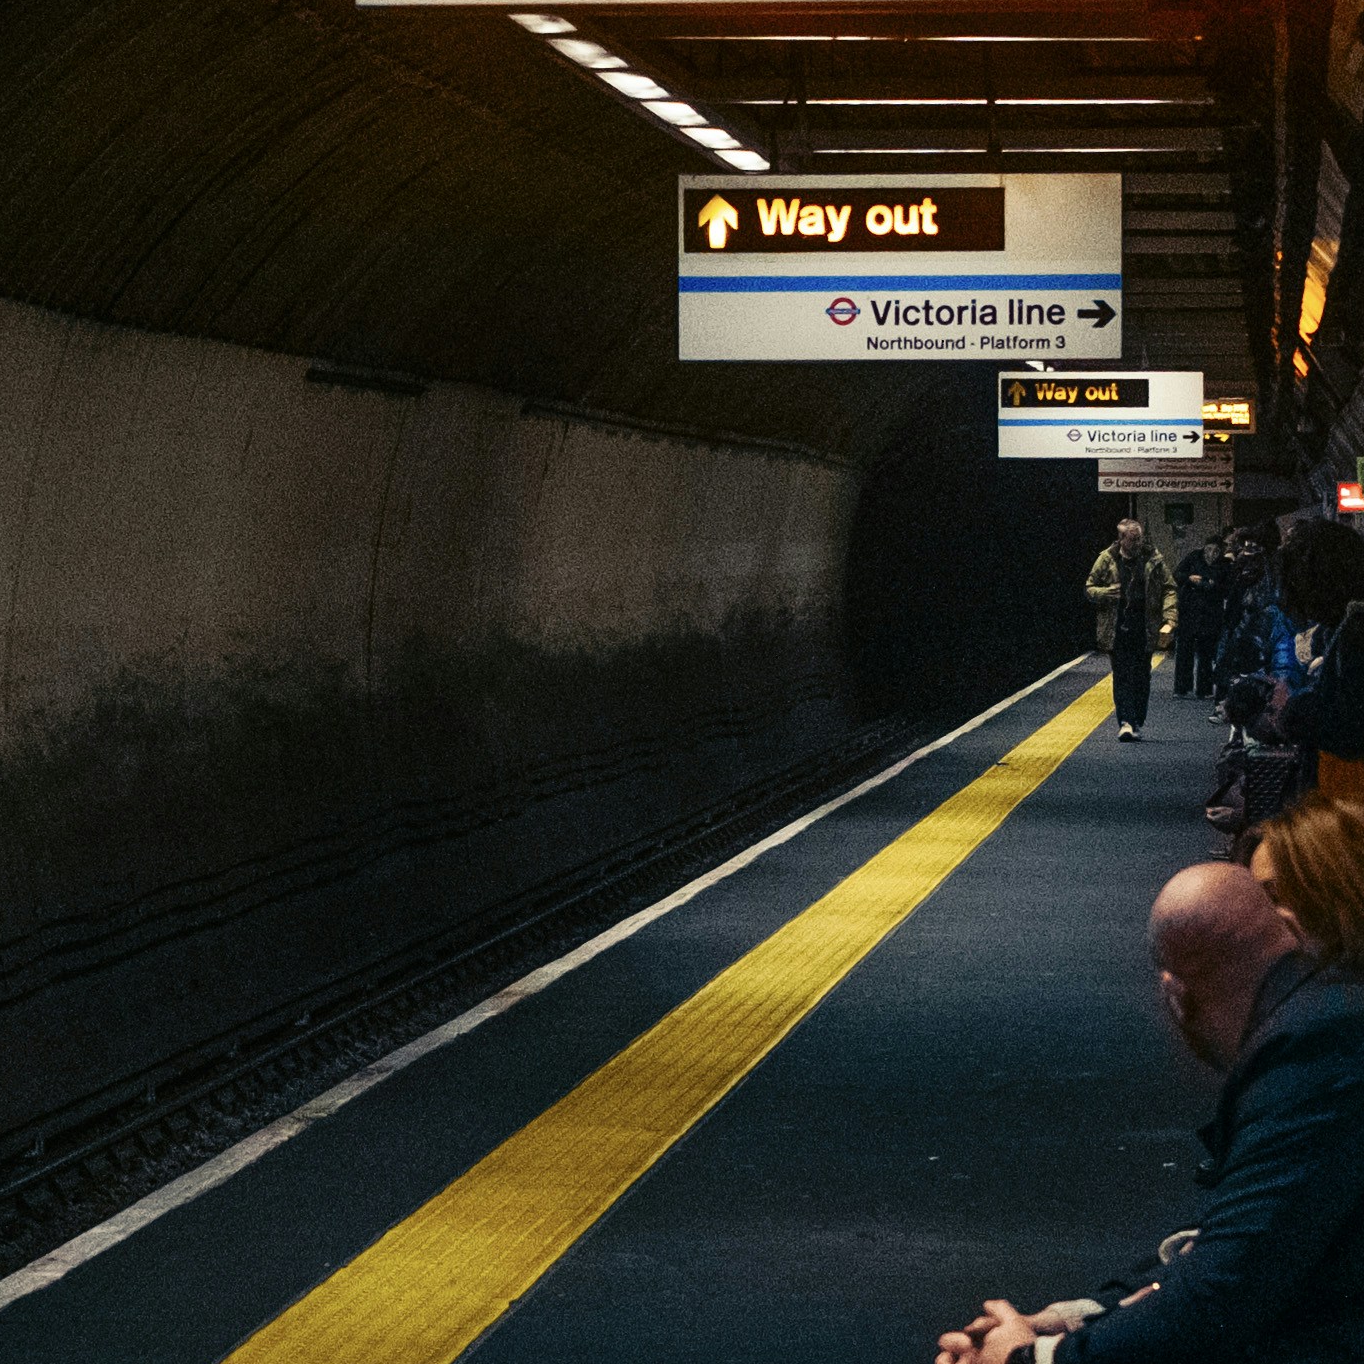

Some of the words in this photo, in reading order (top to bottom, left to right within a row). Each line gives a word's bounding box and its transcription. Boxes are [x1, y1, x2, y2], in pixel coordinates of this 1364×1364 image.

[756, 198, 851, 242] Way
[865, 197, 939, 235] out
[870, 298, 997, 326] Victoria
[1008, 298, 1066, 325] line
[866, 336, 966, 351] Northbound
[979, 336, 1051, 350] Platform
[1054, 335, 1066, 350] 3
[1036, 382, 1079, 404] Way
[1085, 382, 1120, 401] out
[1087, 430, 1146, 442] Victoria
[1150, 430, 1178, 442] line
[1116, 479, 1154, 488] London
[1156, 479, 1218, 489] Overground
